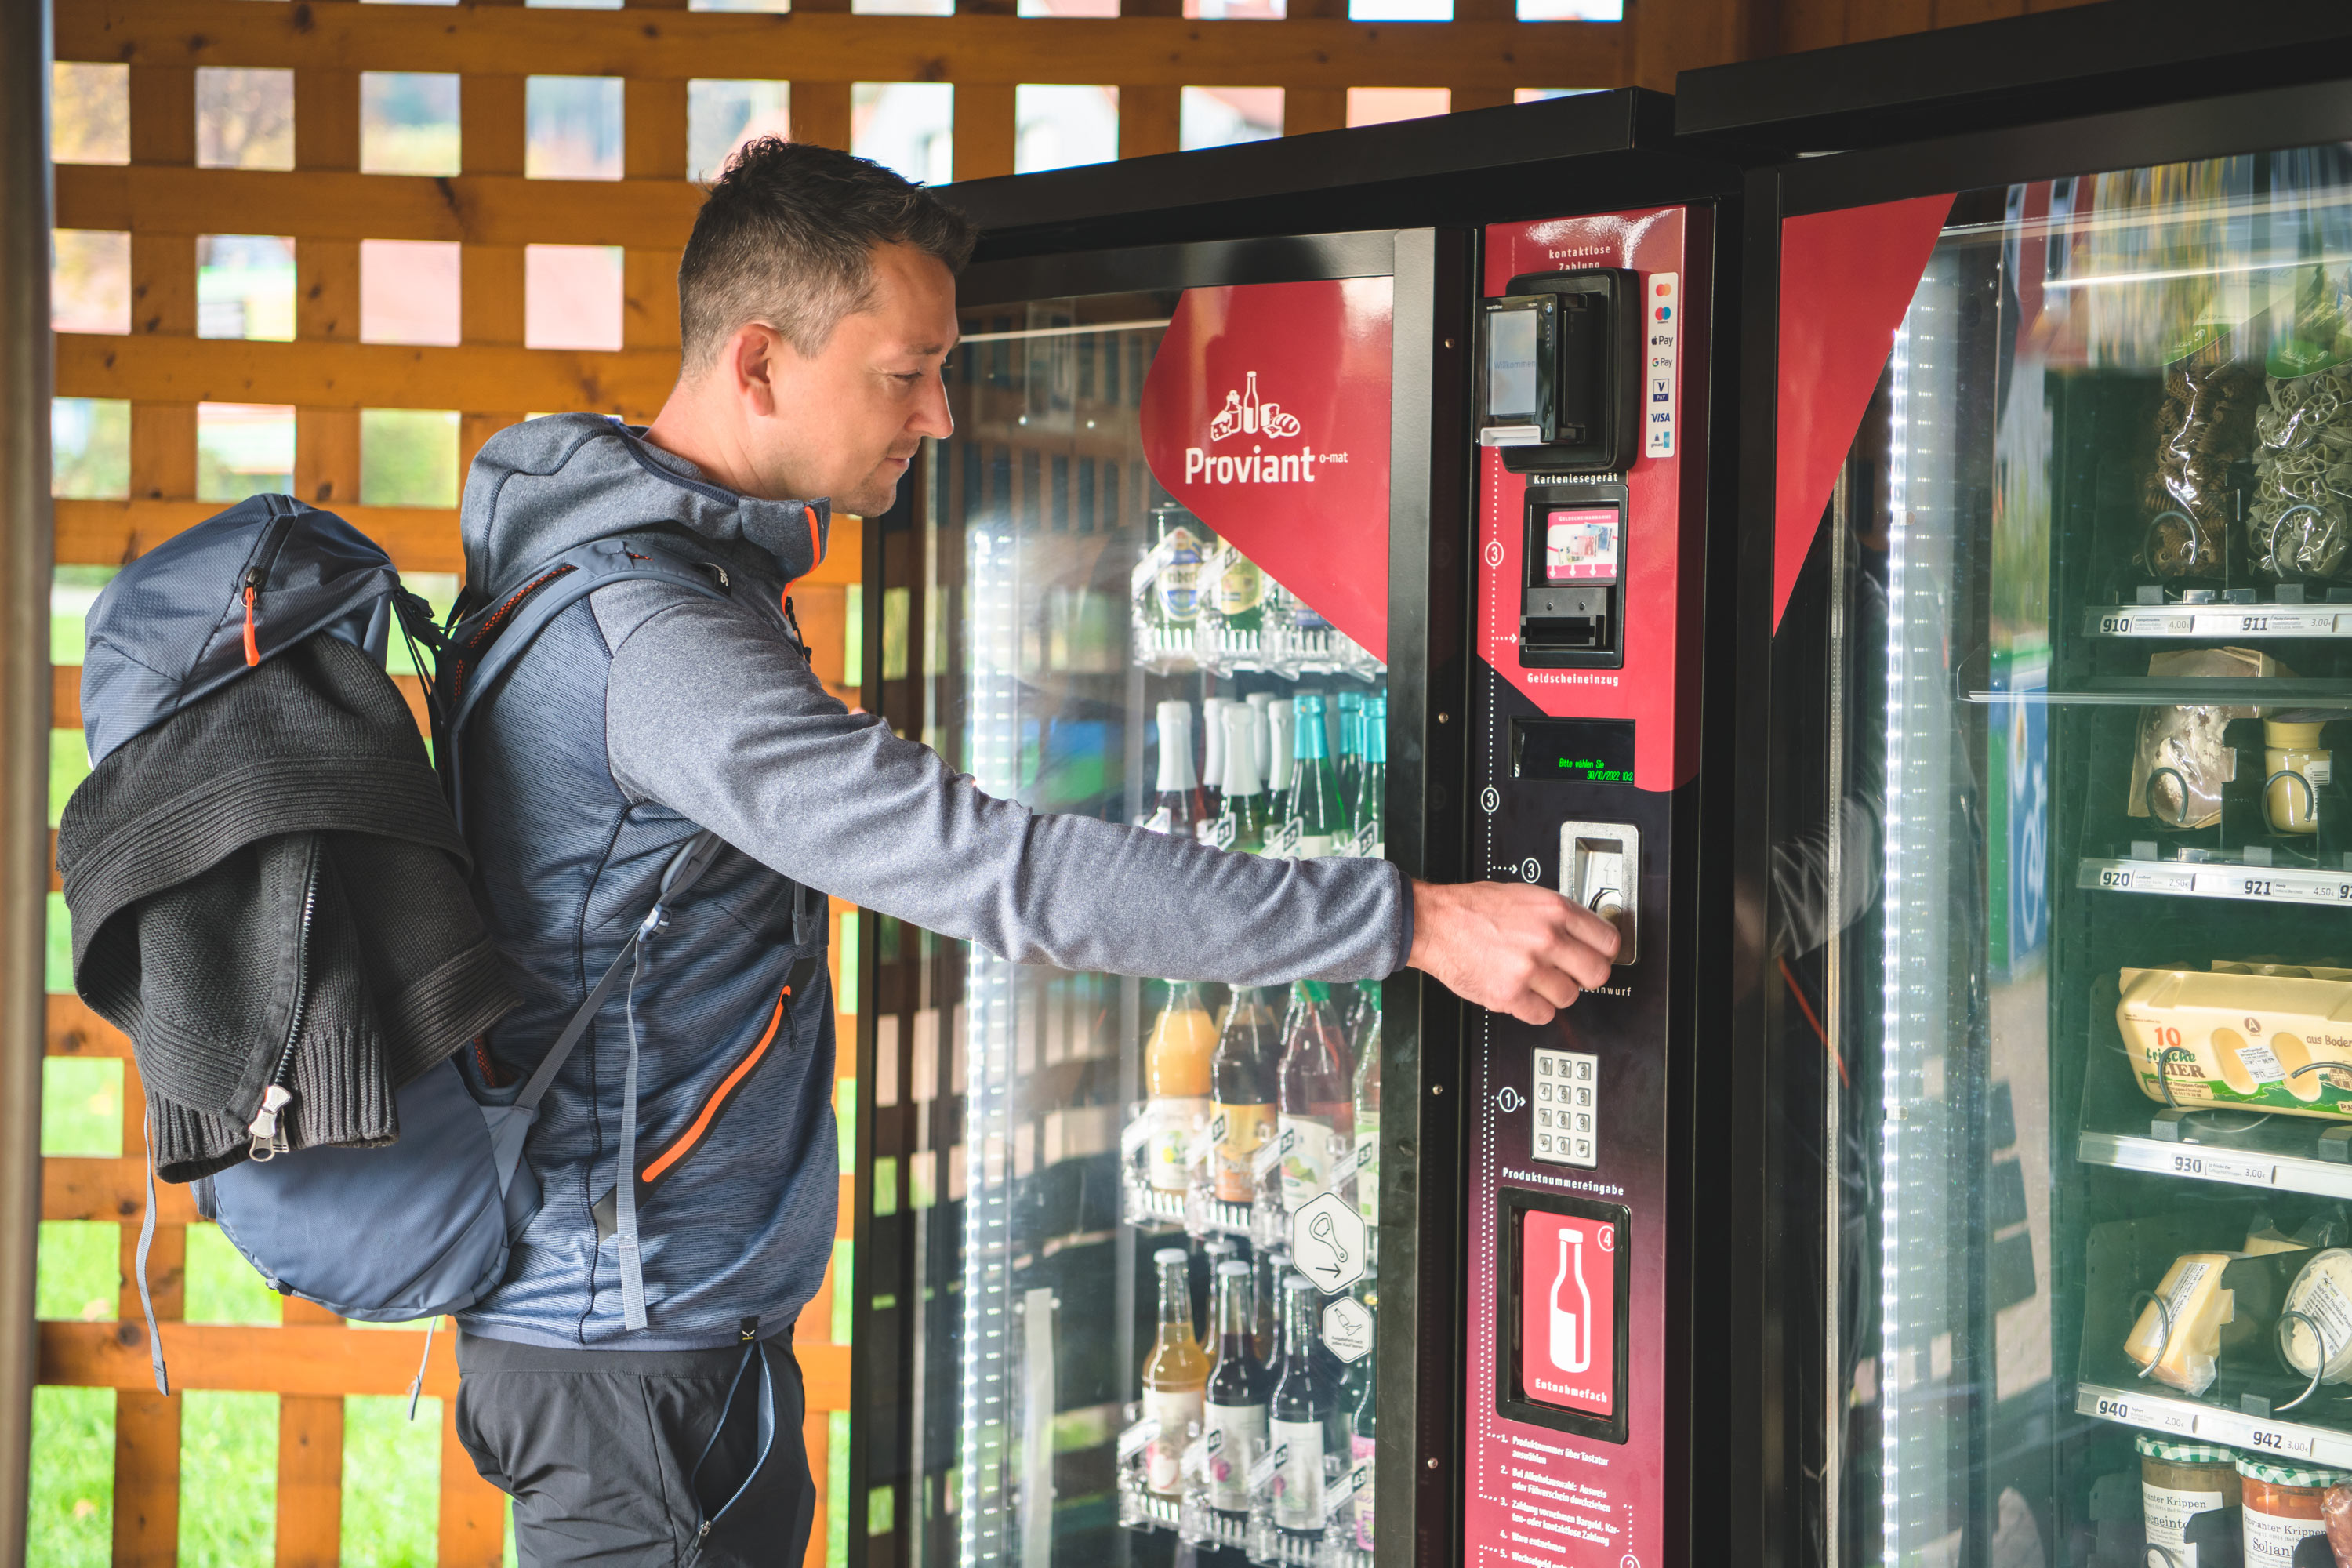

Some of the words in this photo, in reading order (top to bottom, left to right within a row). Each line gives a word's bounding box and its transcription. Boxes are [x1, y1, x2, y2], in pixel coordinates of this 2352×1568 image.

[1548, 245, 1611, 260] kontaktlose
[1559, 261, 1600, 271] Zahlung
[1658, 336, 1674, 347] Pay
[1494, 360, 1536, 368] Willkommen
[1661, 358, 1673, 368] Pay
[1651, 413, 1670, 423] VISA
[1185, 445, 1316, 485] Proviant
[1319, 452, 1348, 464] o-mat
[1534, 473, 1618, 485] Kartenlesegerät
[1491, 546, 1498, 561] 3
[2103, 619, 2129, 632] 910
[2242, 617, 2267, 631] 911
[1527, 673, 1619, 687] Geldscheineinzug
[1559, 757, 1573, 768] Bitte
[1595, 759, 1604, 769] Sie
[1587, 770, 1620, 781] 30/10/2022
[1487, 792, 1494, 808] 3
[1527, 862, 1535, 878] 3
[2103, 872, 2130, 887] 920
[2245, 880, 2271, 895] 921
[2154, 1027, 2181, 1047] 10
[2306, 1036, 2322, 1044] aus
[1505, 1092, 1511, 1108] 1
[2175, 1156, 2202, 1173] 930
[1502, 1167, 1624, 1196] Produktnummereingabe
[1603, 1231, 1611, 1247] 4
[1535, 1378, 1607, 1403] Entnahmefach
[2100, 1401, 2128, 1418] 940
[2253, 1431, 2282, 1449] 942
[1501, 1434, 1508, 1443] 1.
[1512, 1436, 1564, 1456] Produktnummer
[1565, 1448, 1581, 1459] über
[1581, 1451, 1609, 1466] Tastatur
[1512, 1450, 1547, 1465] auswählen
[1500, 1465, 1508, 1474] 2.
[1512, 1468, 1524, 1478] Bei
[1579, 1484, 1607, 1498] Ausweis
[1512, 1481, 1527, 1491] oder
[1528, 1484, 1570, 1502] Führerschein
[1570, 1494, 1611, 1512] durchziehen
[2143, 1492, 2164, 1503] ianter
[2166, 1496, 2206, 1508] Krippen
[1500, 1497, 1508, 1506] 3.
[1512, 1500, 1538, 1515] Zahlung
[1539, 1508, 1575, 1523] vornehmen
[1605, 1523, 1620, 1534] Kar-
[2245, 1513, 2281, 1533] Provianter
[1526, 1517, 1542, 1527] oder
[1543, 1520, 1581, 1537] kontaktlose
[1582, 1530, 1610, 1547] Zahlung
[1500, 1530, 1508, 1539] 4.
[1512, 1532, 1528, 1544] Ware
[1529, 1538, 1566, 1553] entnehmen
[2252, 1537, 2295, 1556] Soljan
[1500, 1548, 1508, 1558] 5.
[1512, 1552, 1551, 1568] Wechselgeld
